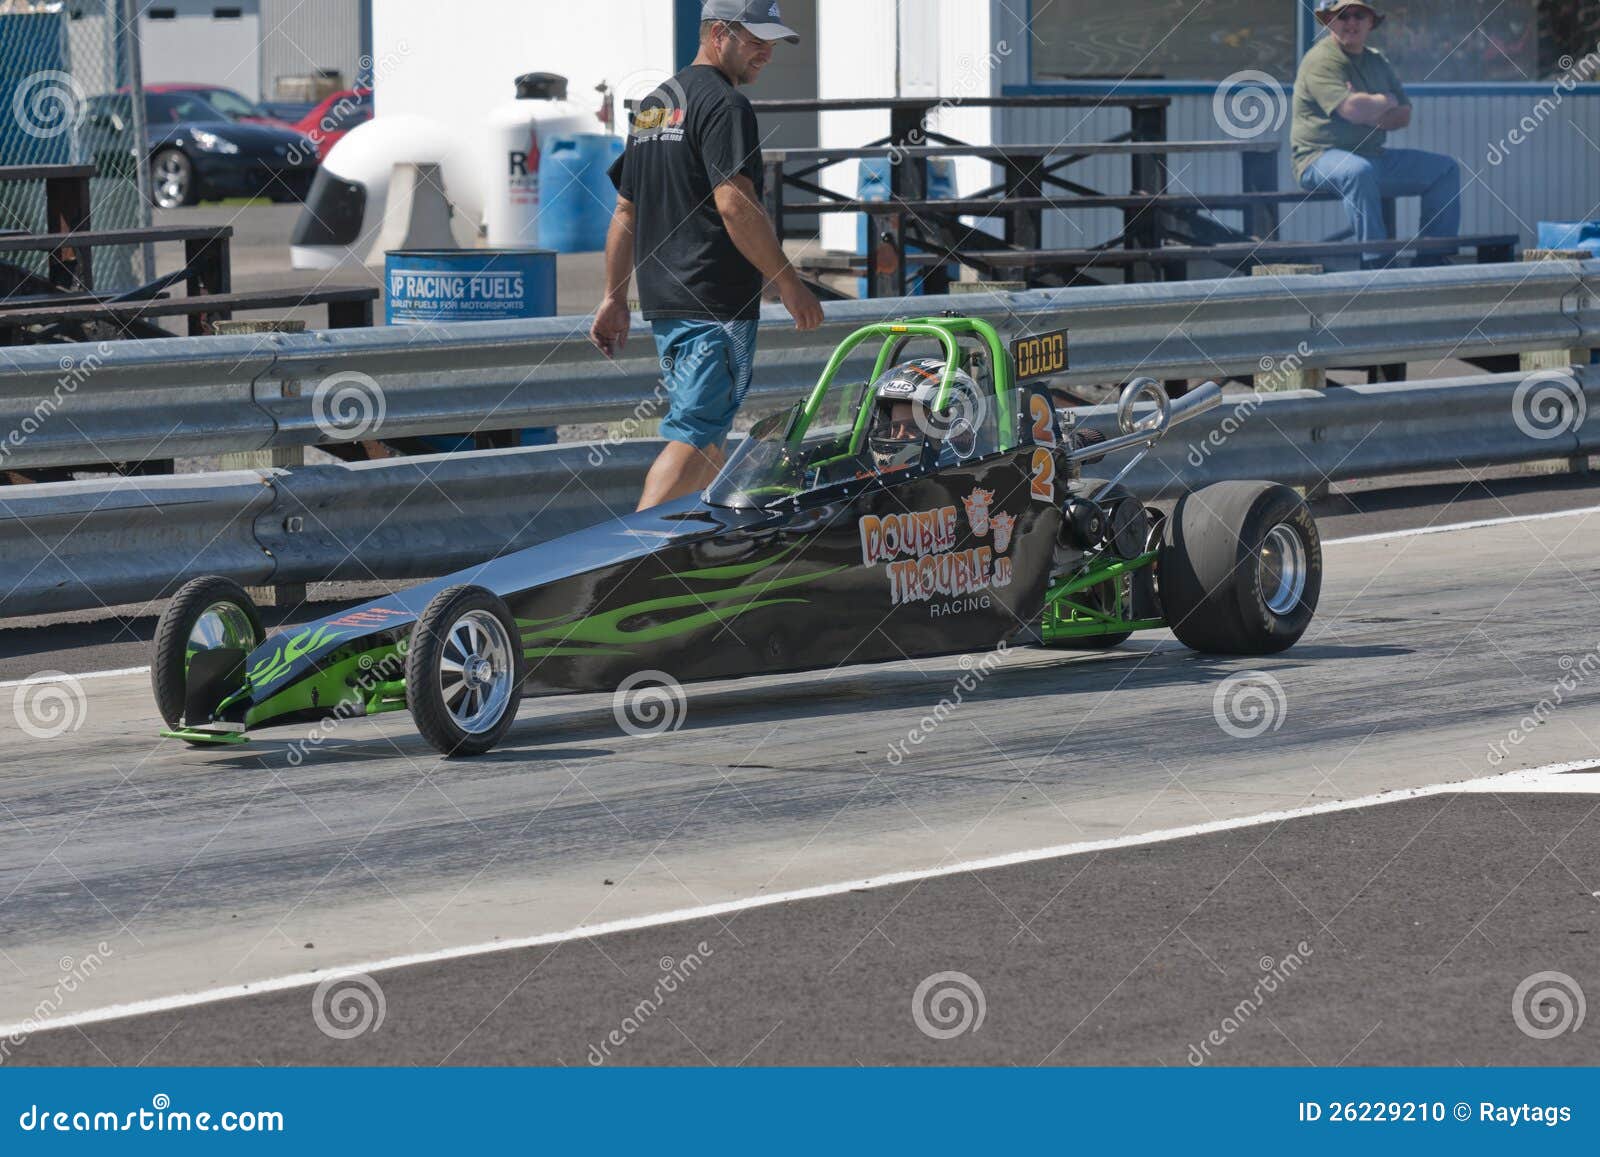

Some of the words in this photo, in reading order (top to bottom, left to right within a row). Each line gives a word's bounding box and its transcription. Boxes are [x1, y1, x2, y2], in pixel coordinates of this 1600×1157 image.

[406, 277, 464, 299] RACING
[471, 277, 524, 299] FUELS
[414, 301, 438, 309] FUELS
[460, 301, 524, 310] MOTORSPORTS
[859, 505, 957, 568] DOUBLE
[886, 545, 992, 605] TROUBLE
[930, 595, 991, 618] RACING
